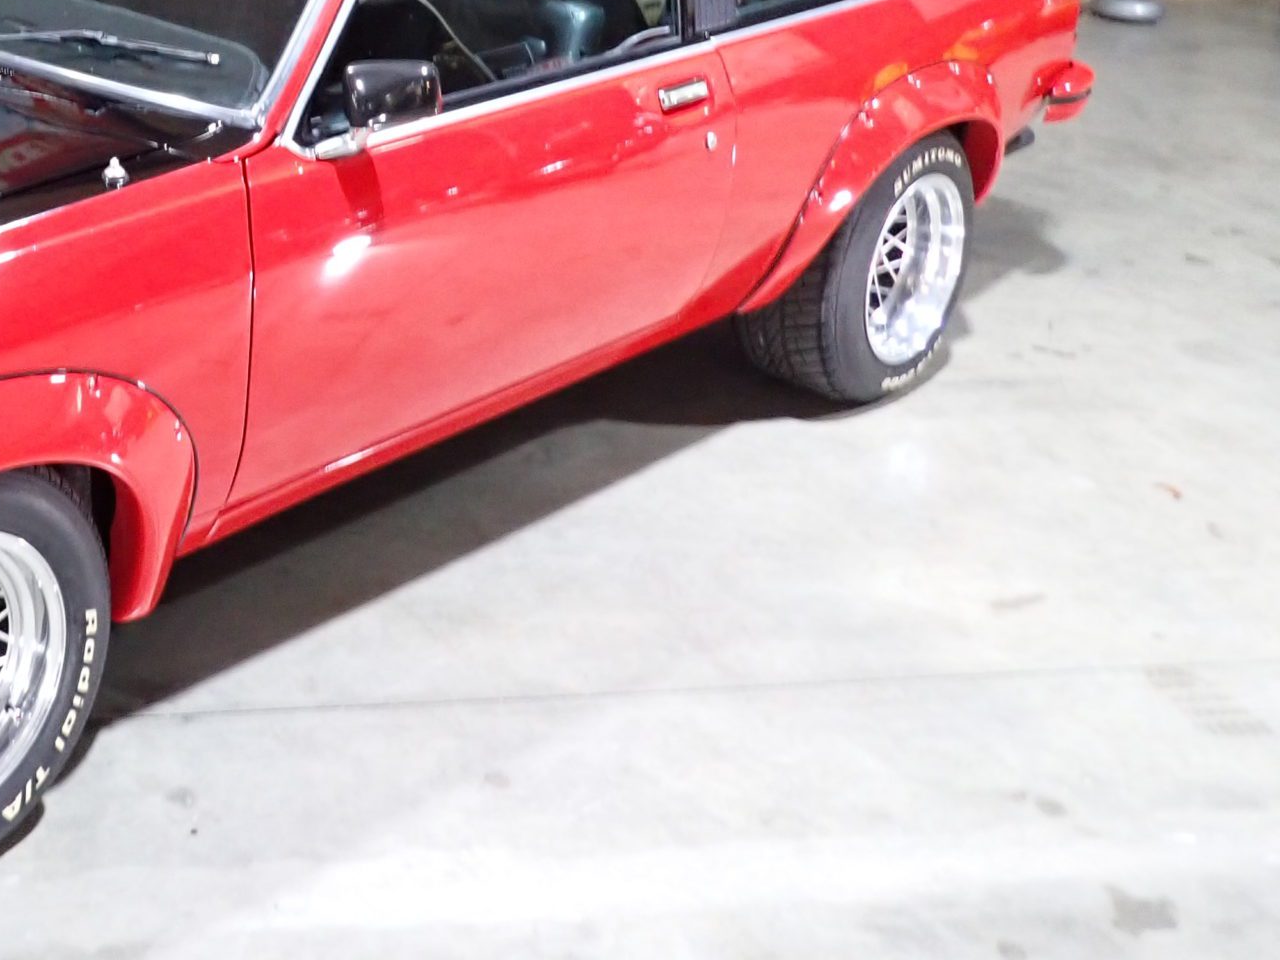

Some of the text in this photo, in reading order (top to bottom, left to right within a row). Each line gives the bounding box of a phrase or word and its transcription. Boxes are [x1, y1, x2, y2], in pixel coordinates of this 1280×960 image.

[893, 146, 962, 199] SUMITOMO
[1, 608, 99, 822] Radial T/A
